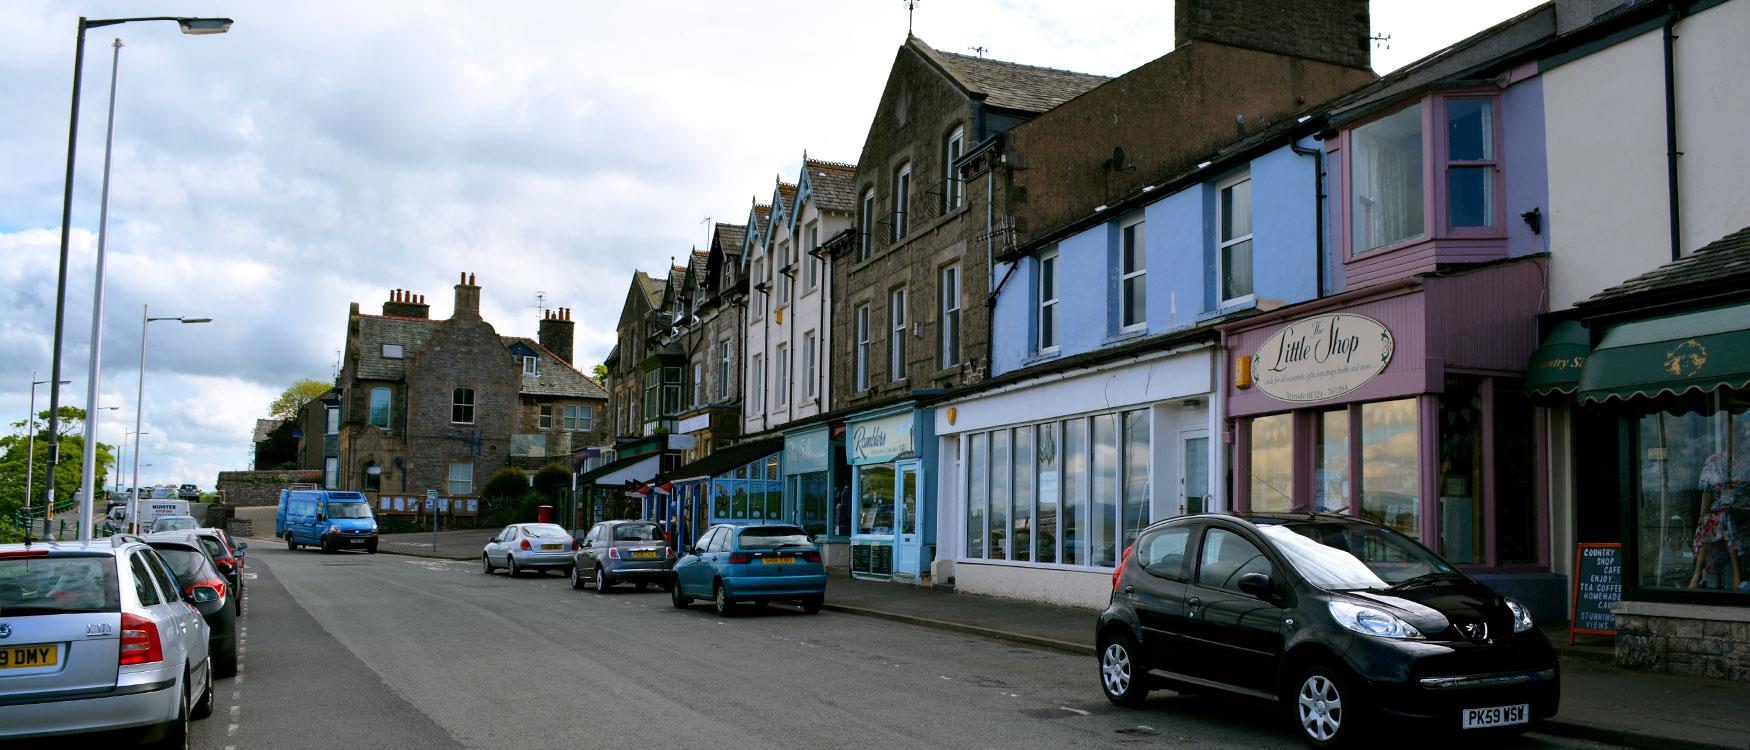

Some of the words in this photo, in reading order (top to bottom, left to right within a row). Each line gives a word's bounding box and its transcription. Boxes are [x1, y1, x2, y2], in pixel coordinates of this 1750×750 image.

[1268, 327, 1311, 372] Little
[1314, 315, 1359, 363] Shop
[1583, 548, 1615, 557] COUNTRY
[1596, 558, 1614, 566] SHOP
[1603, 566, 1621, 574] CAFE
[1583, 592, 1621, 600] HOMEMADE
[1581, 612, 1616, 621] STUNNING
[15, 648, 49, 664] DMY
[1469, 709, 1500, 725] PK59
[1504, 705, 1524, 722] WSW
